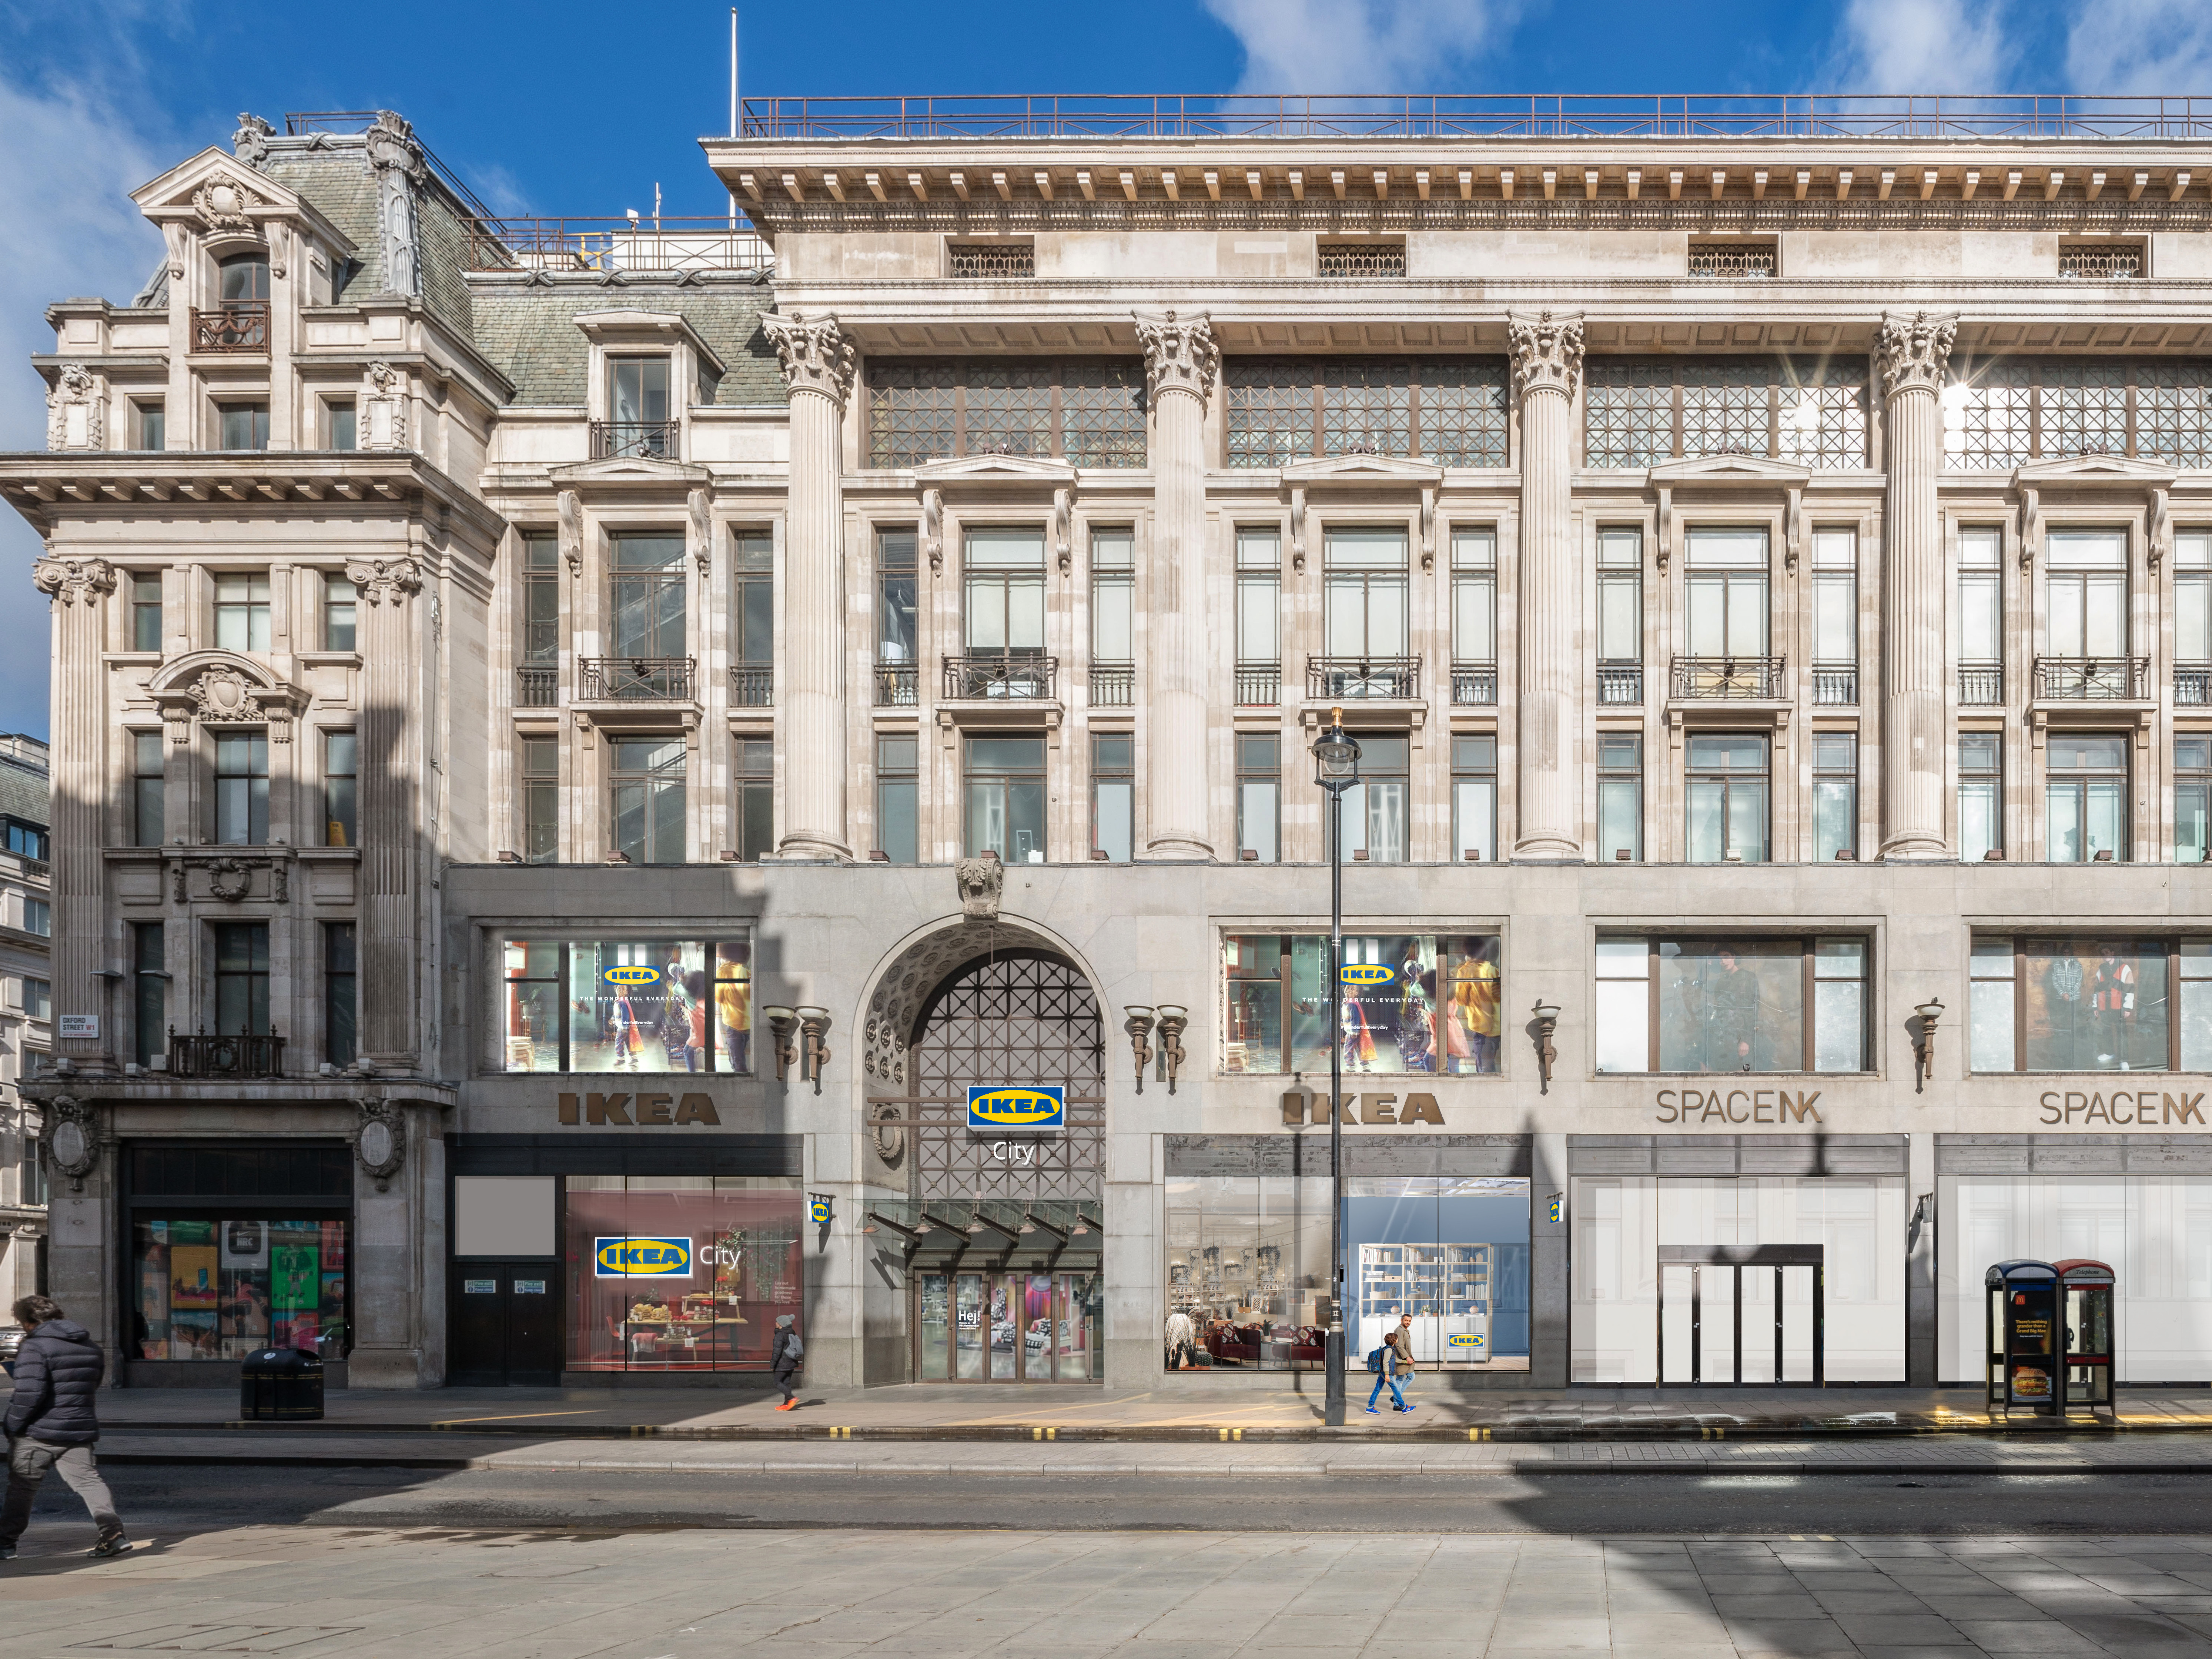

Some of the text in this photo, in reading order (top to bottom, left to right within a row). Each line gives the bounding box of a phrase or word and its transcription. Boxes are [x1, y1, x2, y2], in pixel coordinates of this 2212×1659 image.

[1343, 970, 1388, 979] IKEA
[558, 1093, 721, 1125] IKEA
[979, 1098, 1055, 1113] IKEA
[1283, 1093, 1445, 1125] IKEA
[994, 1141, 1034, 1165] City
[813, 1207, 828, 1217] IKEA
[606, 1245, 741, 1269] IKEA City
[958, 1310, 980, 1324] Hej!
